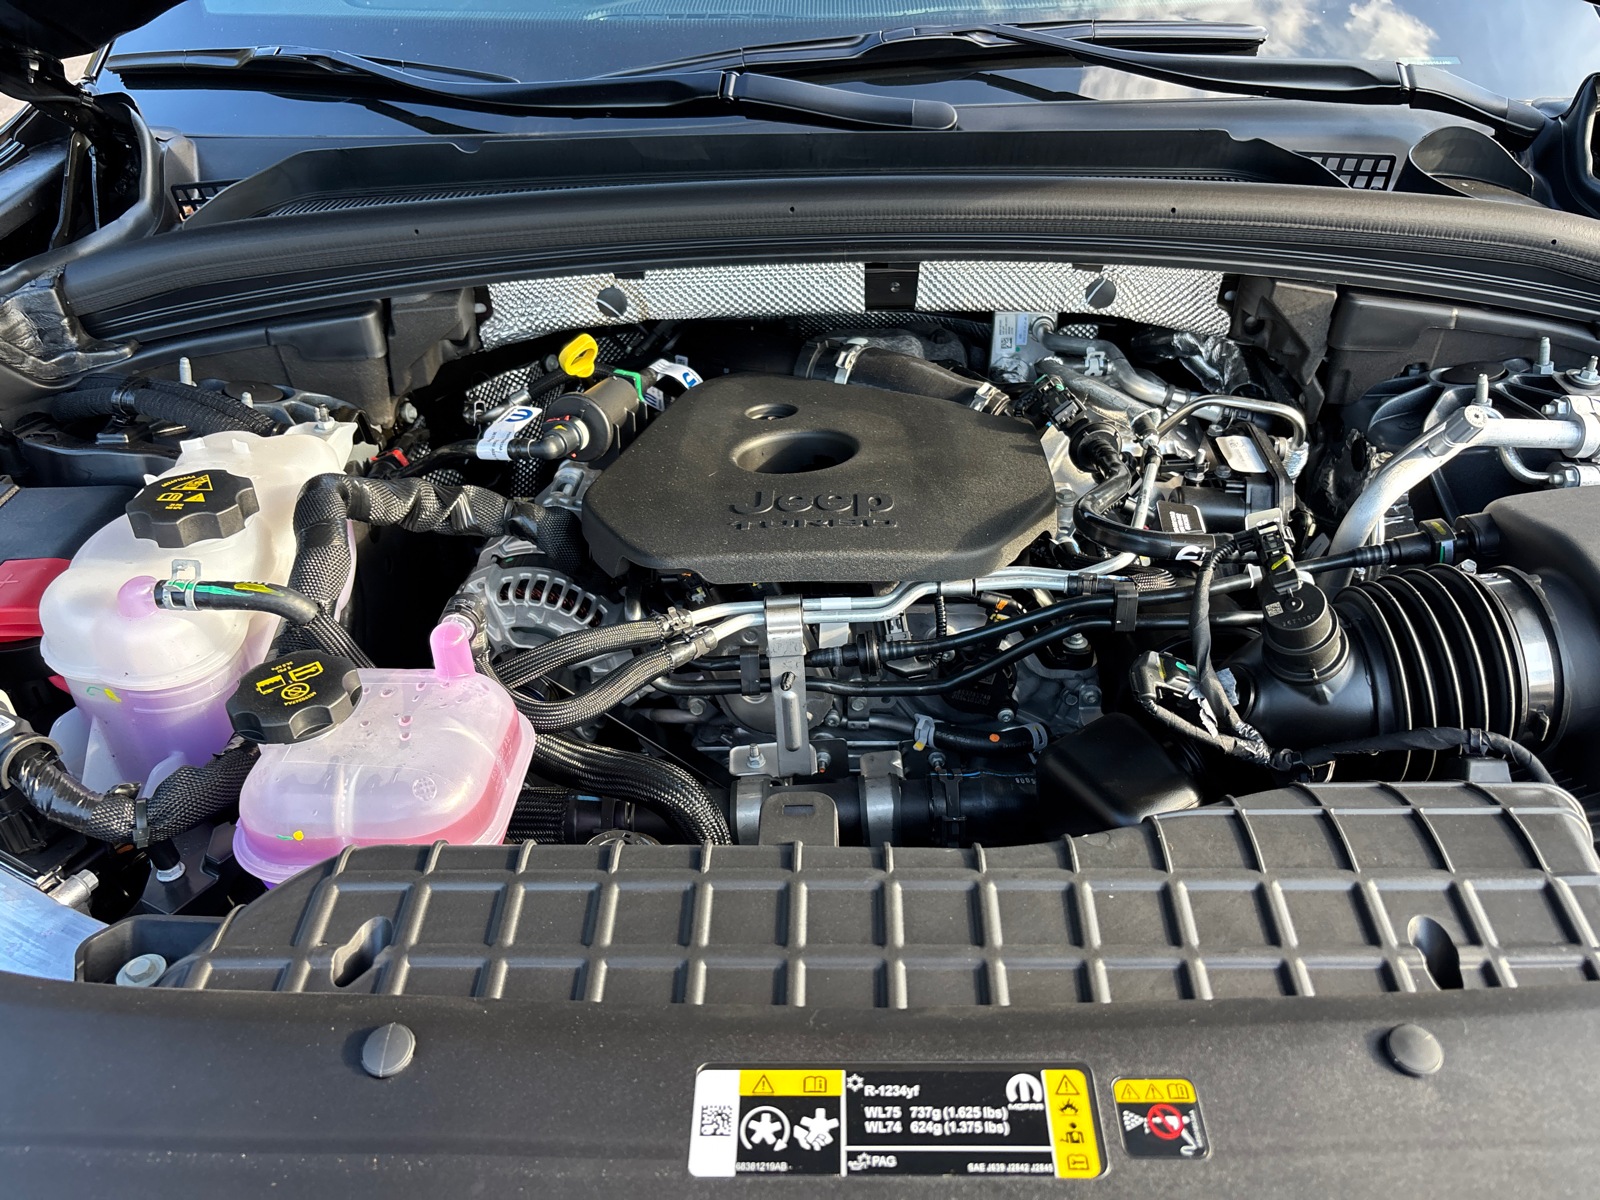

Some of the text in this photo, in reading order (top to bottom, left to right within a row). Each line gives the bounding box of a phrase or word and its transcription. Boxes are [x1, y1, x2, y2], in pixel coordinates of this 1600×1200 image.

[728, 490, 895, 517] Jeep
[864, 1085, 920, 1099] R-1234yf
[864, 1106, 1009, 1121] WL75 737g (1.625 lbs)
[864, 1121, 1011, 1136] WL74 624g (1.375 lbs)
[871, 1155, 897, 1167] PAG
[967, 1163, 986, 1173] SAE
